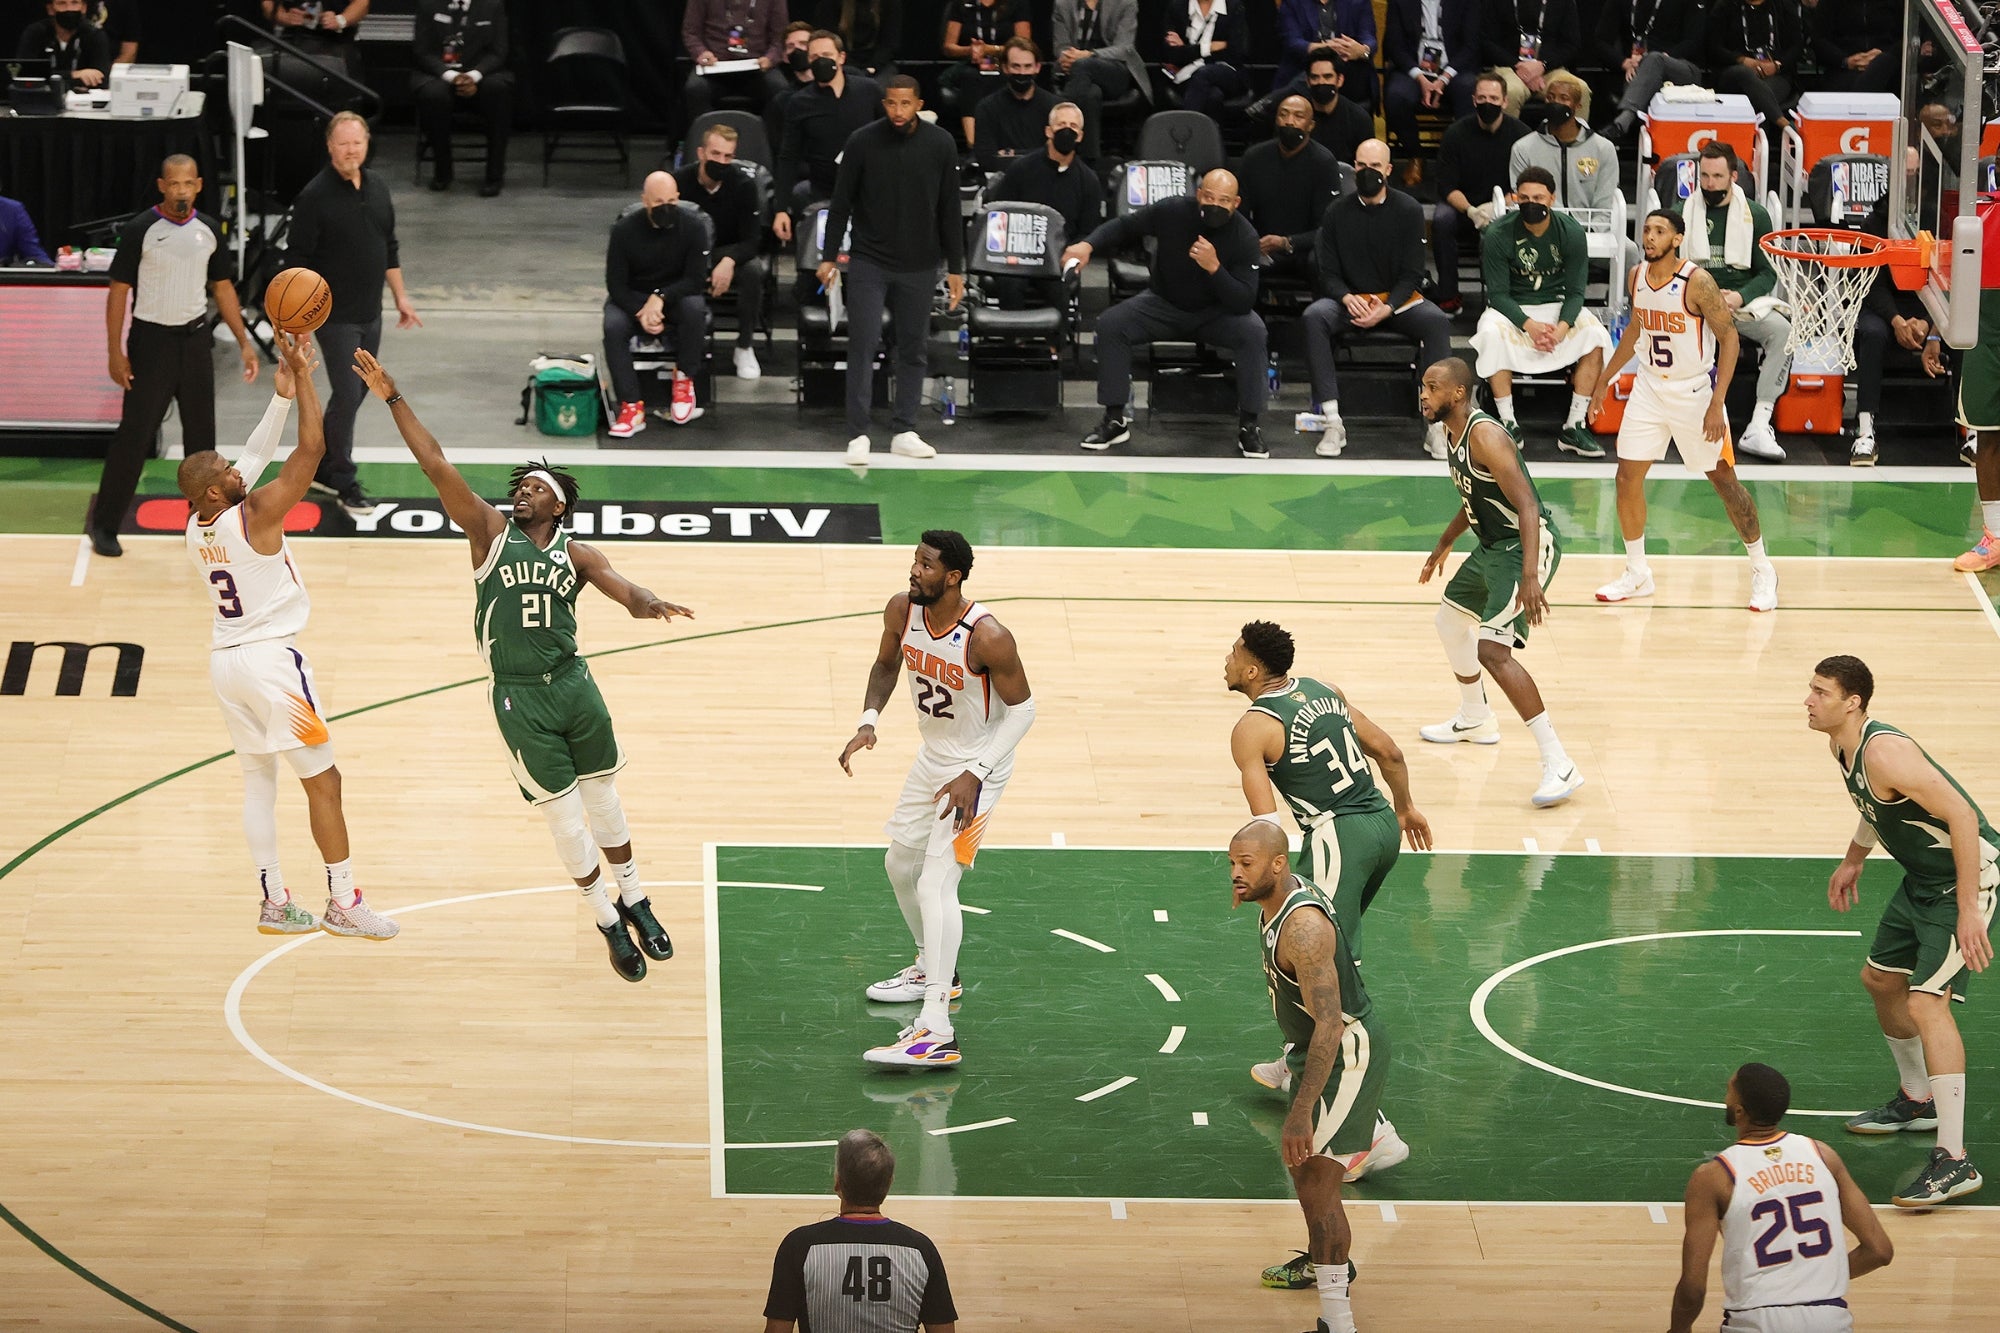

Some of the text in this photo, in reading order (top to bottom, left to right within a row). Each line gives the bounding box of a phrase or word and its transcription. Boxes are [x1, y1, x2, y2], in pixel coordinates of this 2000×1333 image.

[1840, 127, 1869, 154] G
[1148, 166, 1171, 184] NBA
[1852, 162, 1874, 183] NBA
[1008, 212, 1033, 233] NBA
[1007, 232, 1047, 254] FINALS
[199, 546, 231, 566] PAUL
[209, 570, 244, 619] 3
[498, 561, 577, 598] BUCKS
[521, 593, 552, 628] 21
[915, 675, 955, 720] 22
[1309, 726, 1371, 795] 34
[1747, 1162, 1816, 1195] BRIDGES
[1750, 1190, 1834, 1269] 25
[841, 1255, 892, 1303] 48
